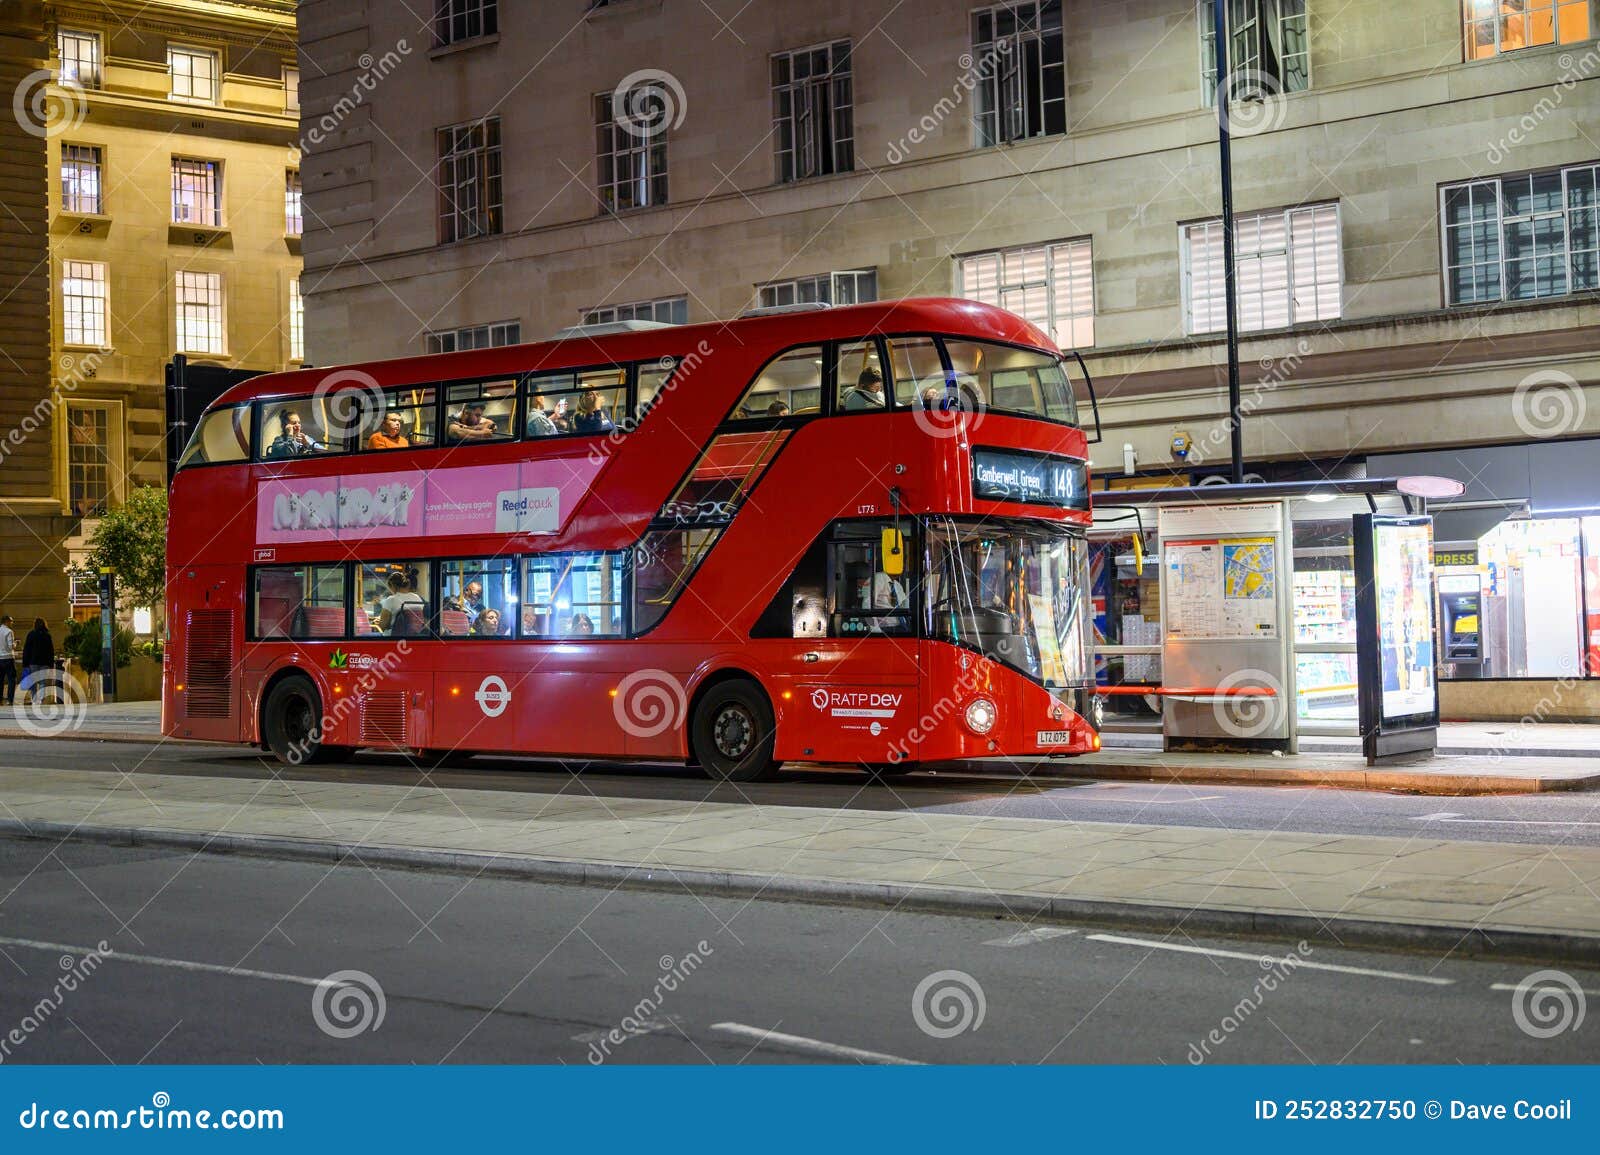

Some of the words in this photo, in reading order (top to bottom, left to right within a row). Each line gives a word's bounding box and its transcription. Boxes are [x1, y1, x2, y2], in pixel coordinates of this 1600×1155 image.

[976, 464, 1019, 486] Camberwell
[1021, 470, 1041, 489] Green
[1054, 468, 1073, 497] 148
[502, 497, 553, 512] Reed.co.uk
[857, 504, 875, 514] LT75
[1435, 554, 1474, 564] PRESS
[831, 693, 869, 706] RATP
[1040, 732, 1053, 743] LTZ
[1053, 732, 1067, 742] 1075
